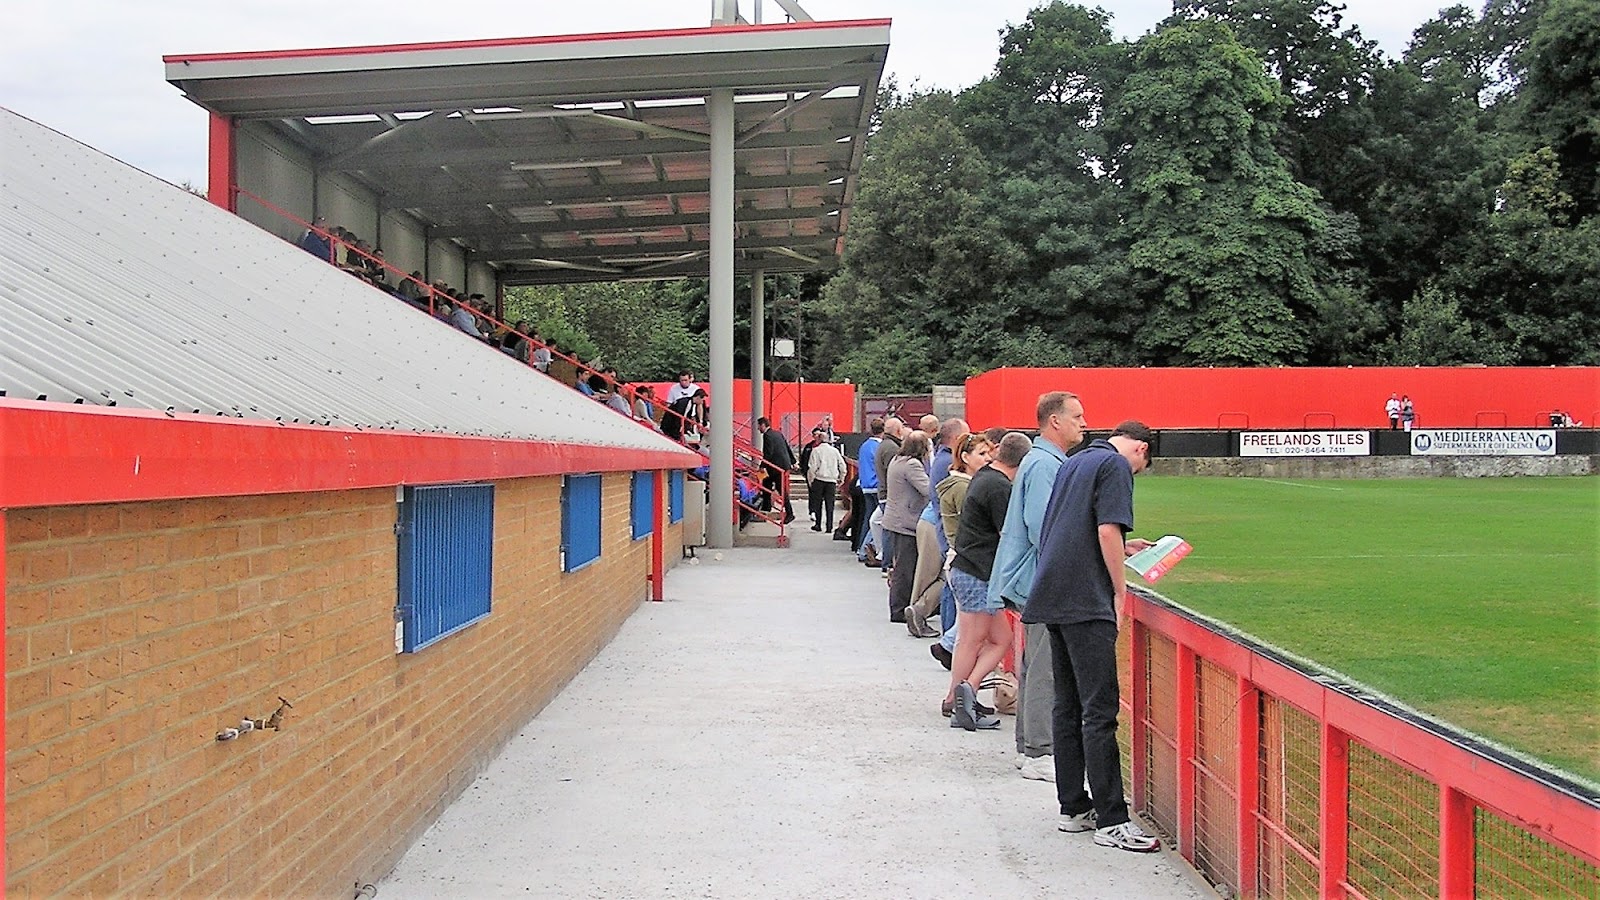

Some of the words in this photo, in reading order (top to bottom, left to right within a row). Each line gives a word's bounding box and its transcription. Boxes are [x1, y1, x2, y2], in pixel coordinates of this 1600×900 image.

[1243, 434, 1321, 446] FREELANDS
[1326, 434, 1364, 445] TILES
[1434, 432, 1534, 442] MEDITERRANEAN
